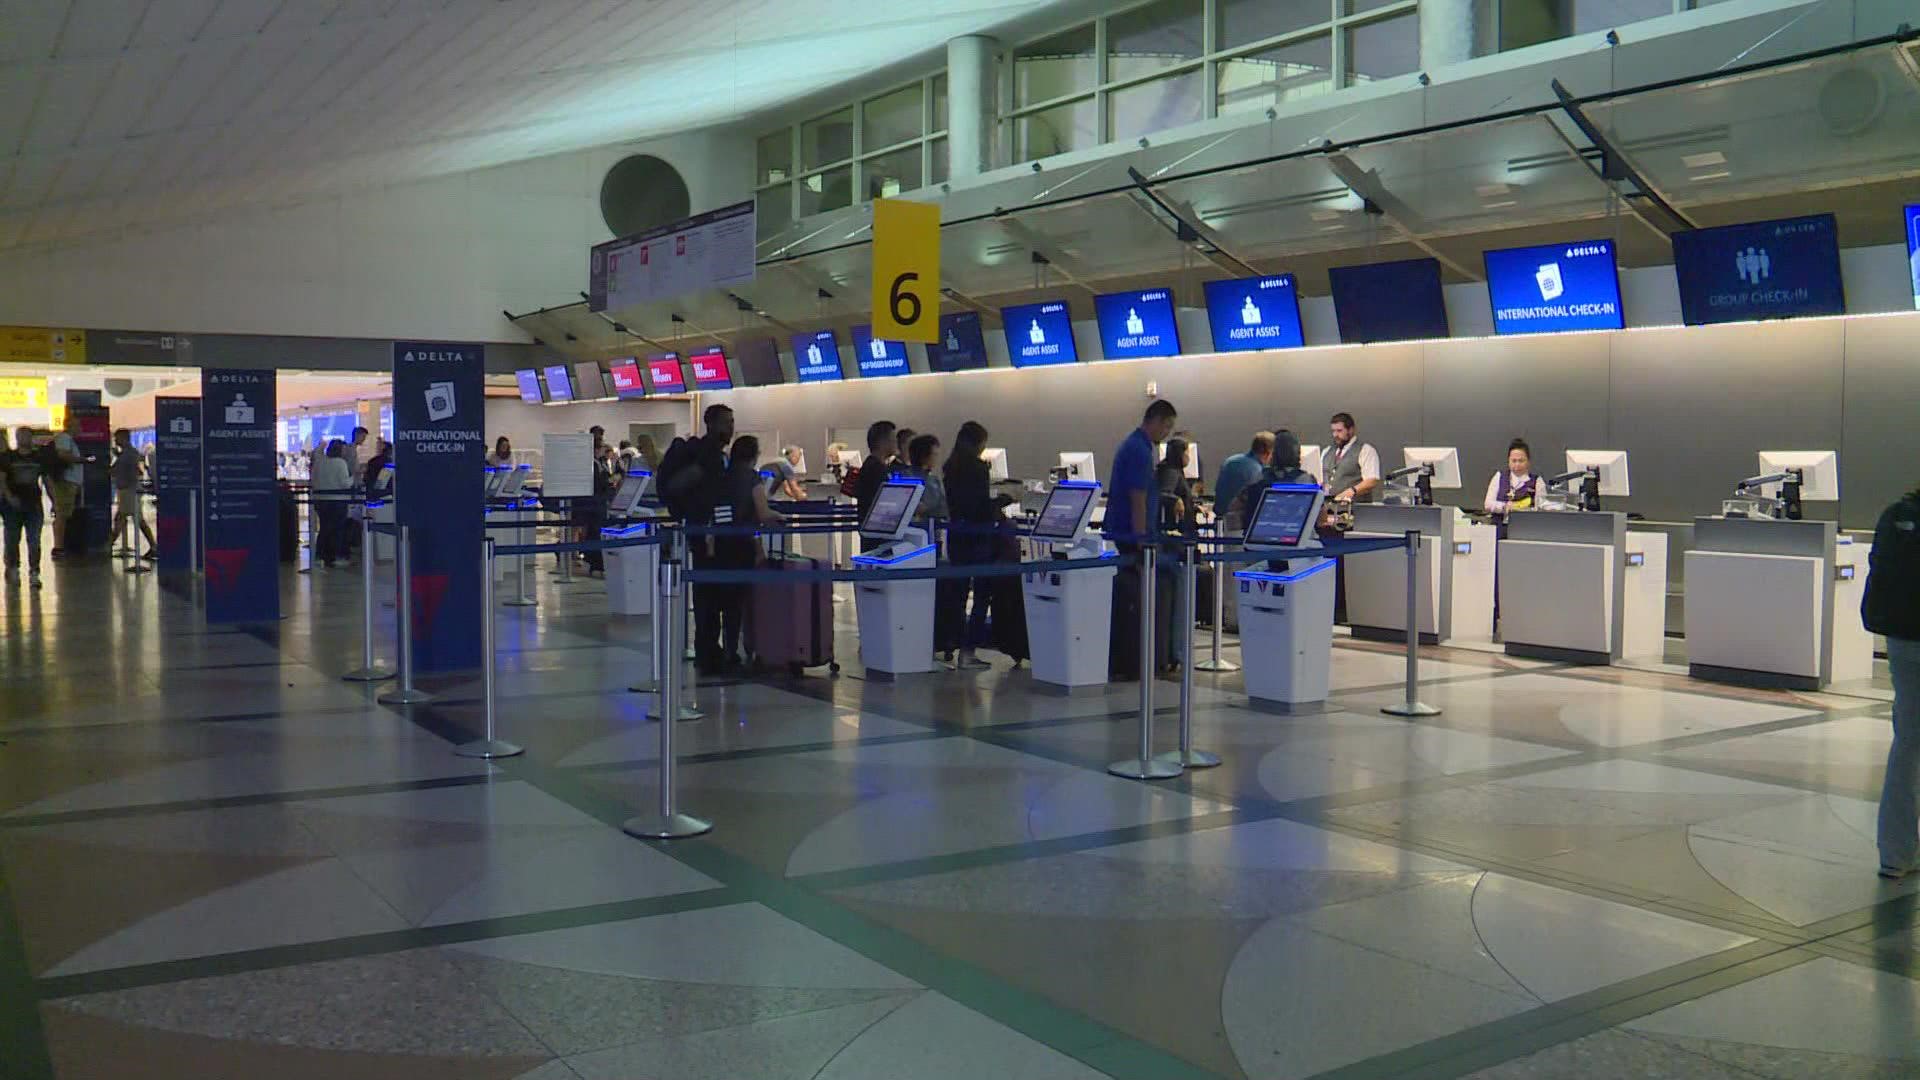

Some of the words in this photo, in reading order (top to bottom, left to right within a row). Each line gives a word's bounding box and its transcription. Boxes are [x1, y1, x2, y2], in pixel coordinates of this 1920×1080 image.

[1574, 247, 1599, 256] DELTA
[890, 272, 921, 326] 6
[1497, 305, 1569, 320] INTERNATIONAL
[1569, 302, 1615, 316] CHECK-IN
[1230, 327, 1254, 339] AGENT
[1255, 325, 1280, 337] ASSIST
[1117, 336, 1138, 348] AGENT
[1139, 335, 1160, 346] ASSIST
[1022, 345, 1040, 357] AGENT
[1041, 344, 1059, 355] ASSIST
[418, 352, 463, 361] DELTA
[221, 375, 259, 383] DELTA
[209, 429, 240, 438] AGENT
[240, 429, 272, 438] ASSIST
[399, 430, 481, 441] INTERNATIONAL
[416, 442, 465, 453] CHECK-IN
